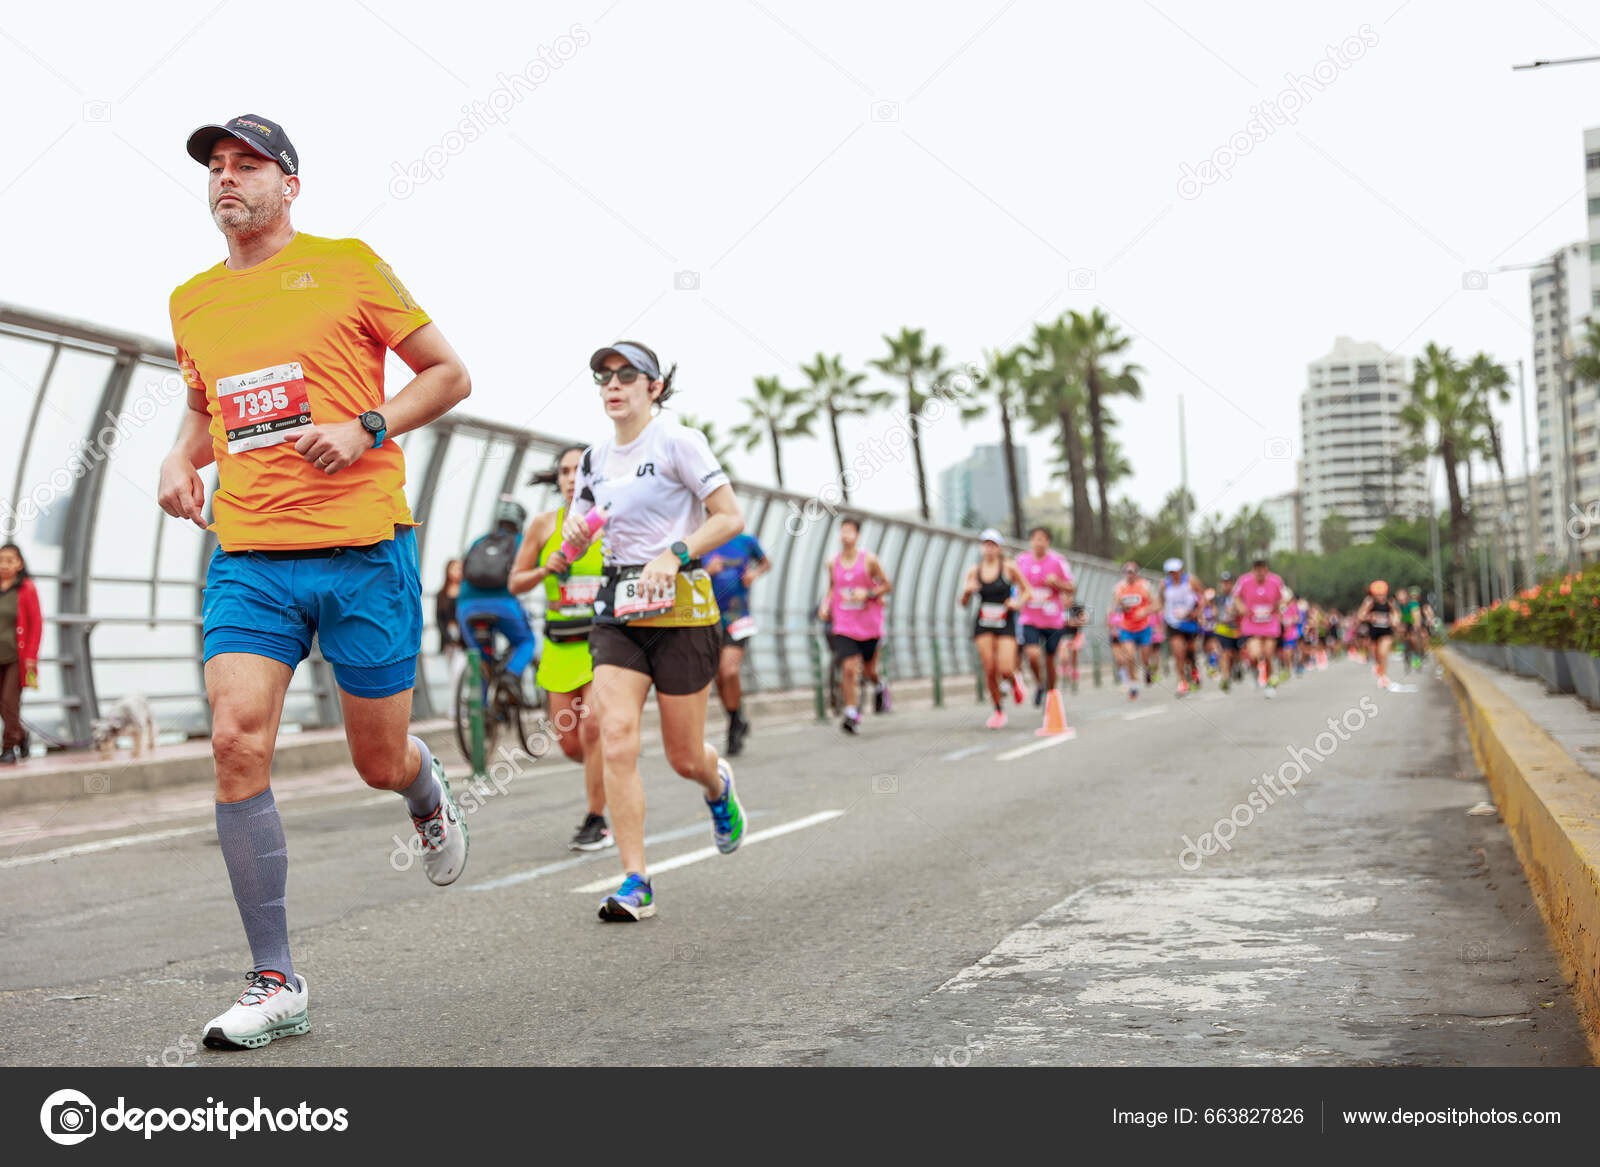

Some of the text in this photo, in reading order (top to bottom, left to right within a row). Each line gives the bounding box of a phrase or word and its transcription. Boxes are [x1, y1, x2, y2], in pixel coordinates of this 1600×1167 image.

[233, 386, 289, 418] 7335
[256, 422, 273, 433] 21K
[636, 462, 655, 477] UR
